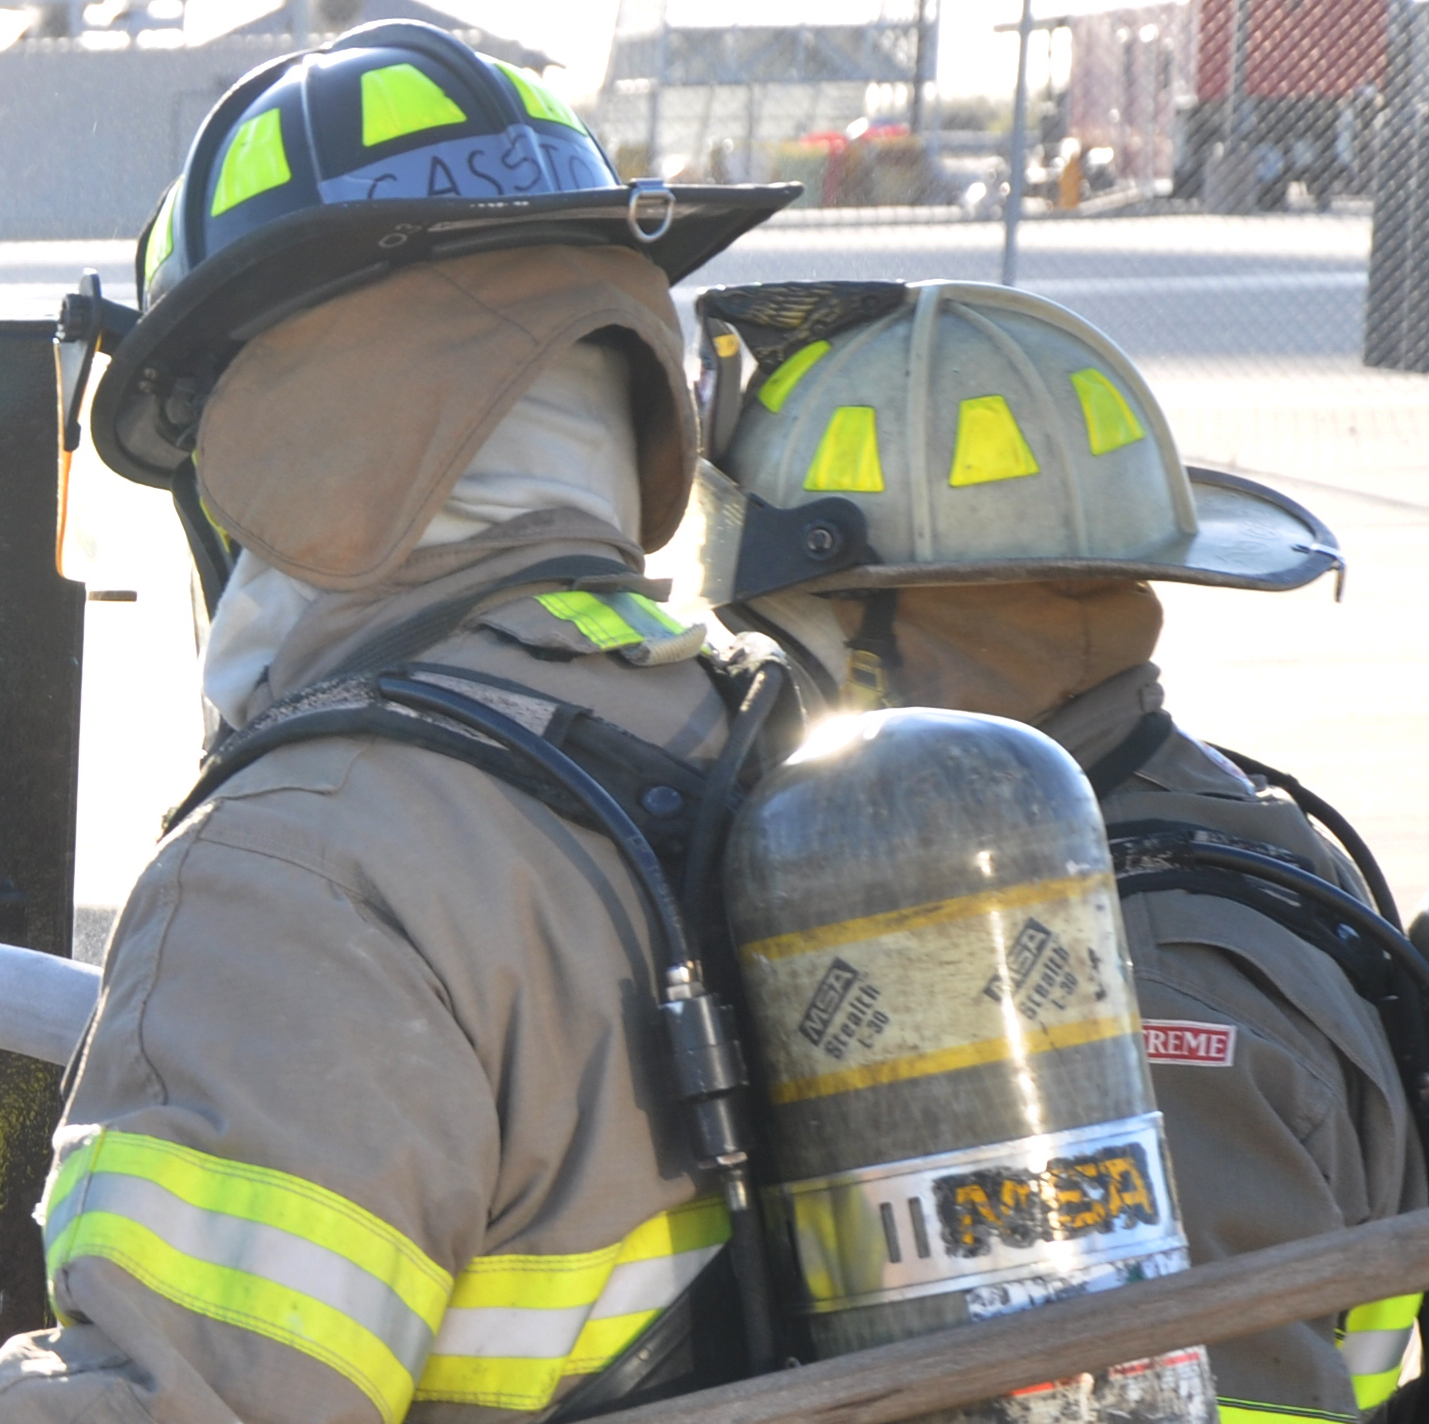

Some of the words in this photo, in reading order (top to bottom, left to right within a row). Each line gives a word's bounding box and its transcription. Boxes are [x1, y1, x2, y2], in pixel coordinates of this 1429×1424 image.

[802, 963, 855, 1042] MSA
[1020, 945, 1070, 1020] Stealth
[824, 984, 881, 1059] Stealth
[1141, 1029, 1227, 1058] REME
